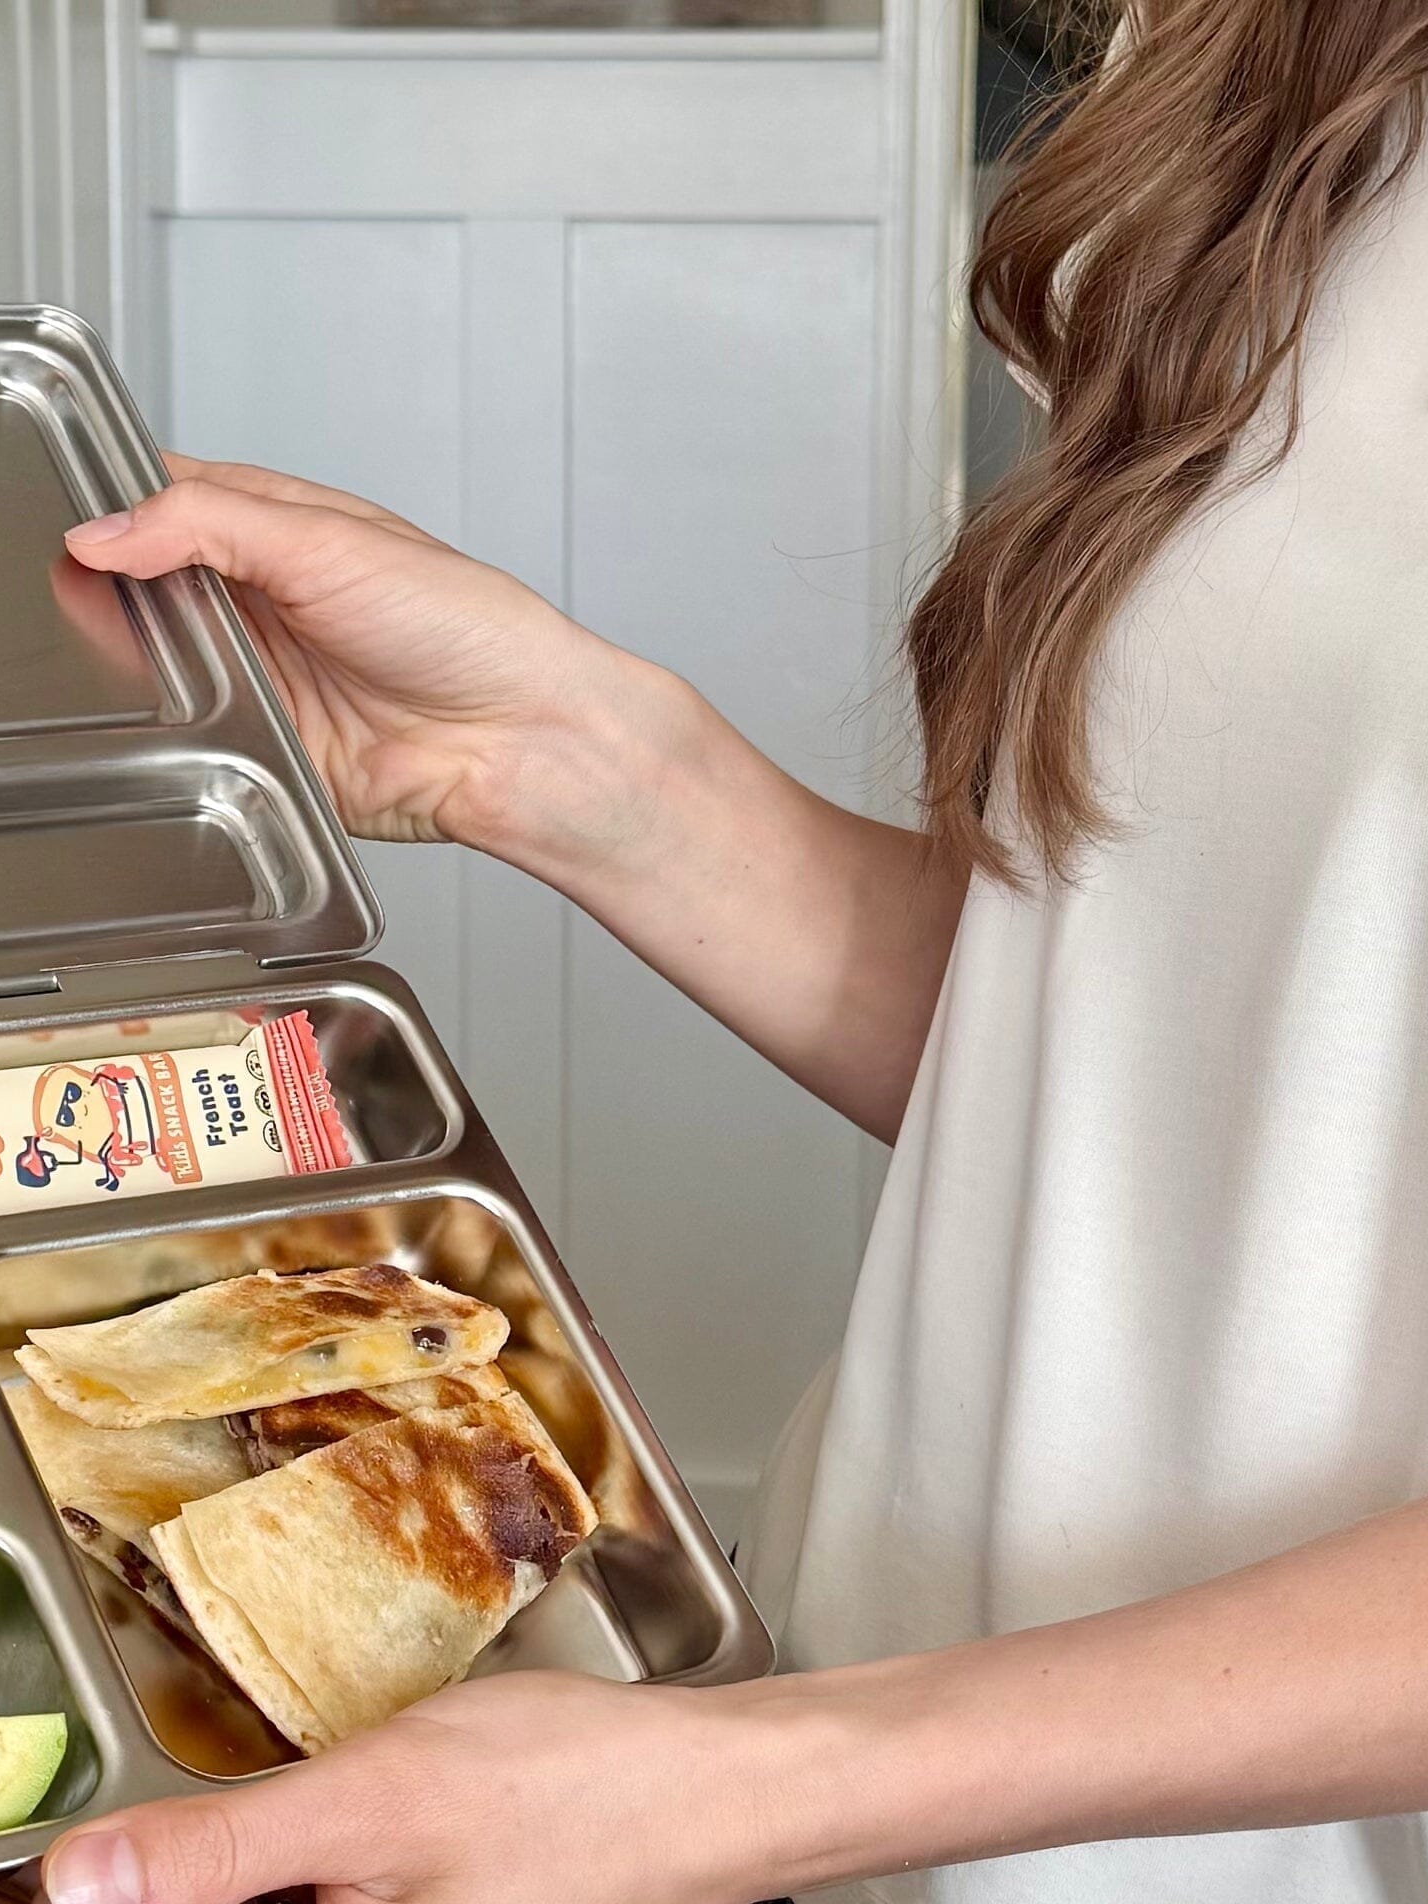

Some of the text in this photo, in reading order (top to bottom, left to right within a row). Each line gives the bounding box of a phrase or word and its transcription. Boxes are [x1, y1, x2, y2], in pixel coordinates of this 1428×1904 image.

[158, 1084, 184, 1137] SNACK
[192, 1069, 226, 1146] French
[217, 1074, 248, 1137] Toast
[168, 1140, 195, 1178] Kids
